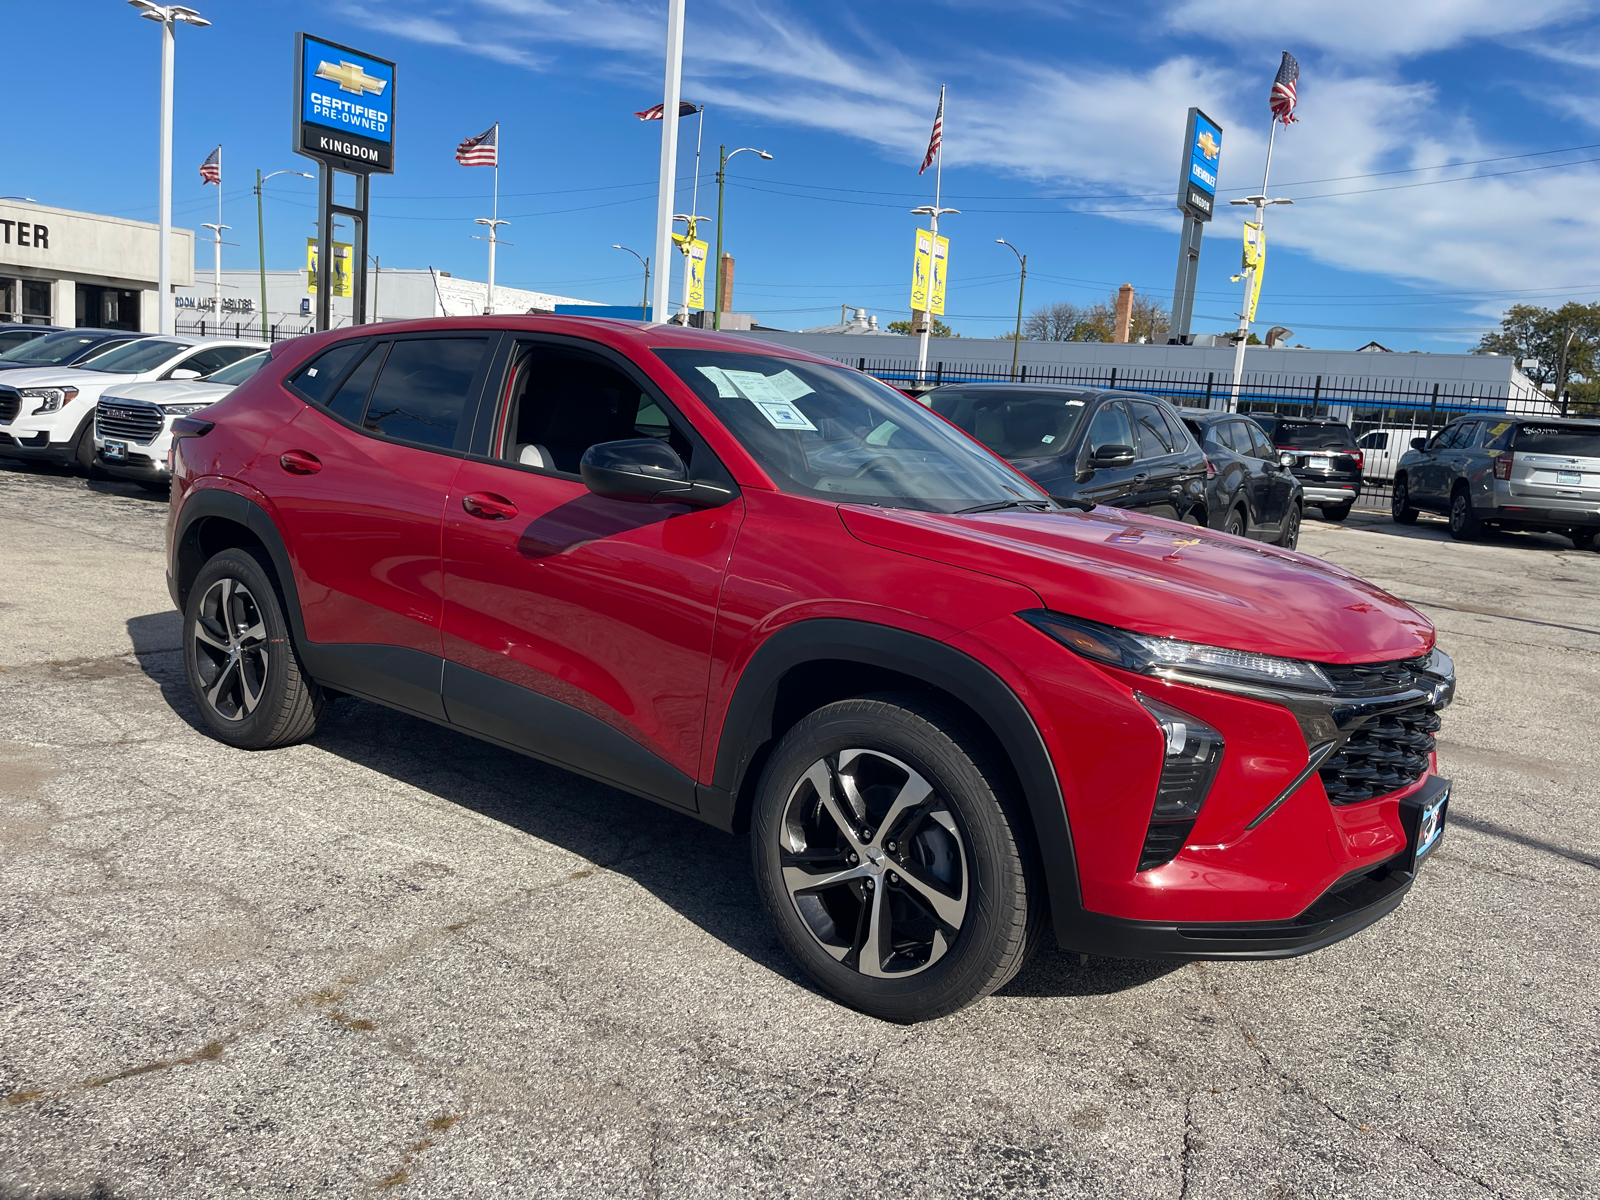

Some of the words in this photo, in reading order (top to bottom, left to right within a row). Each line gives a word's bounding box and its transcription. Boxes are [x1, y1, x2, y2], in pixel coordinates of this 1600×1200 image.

[311, 92, 388, 123] CERTIFIED
[314, 104, 385, 133] PRE-OWNED
[320, 136, 378, 162] KINGDOM
[1193, 163, 1216, 188] CHEVROLET
[1192, 192, 1210, 212] KINGDOM
[0, 218, 49, 249] TER
